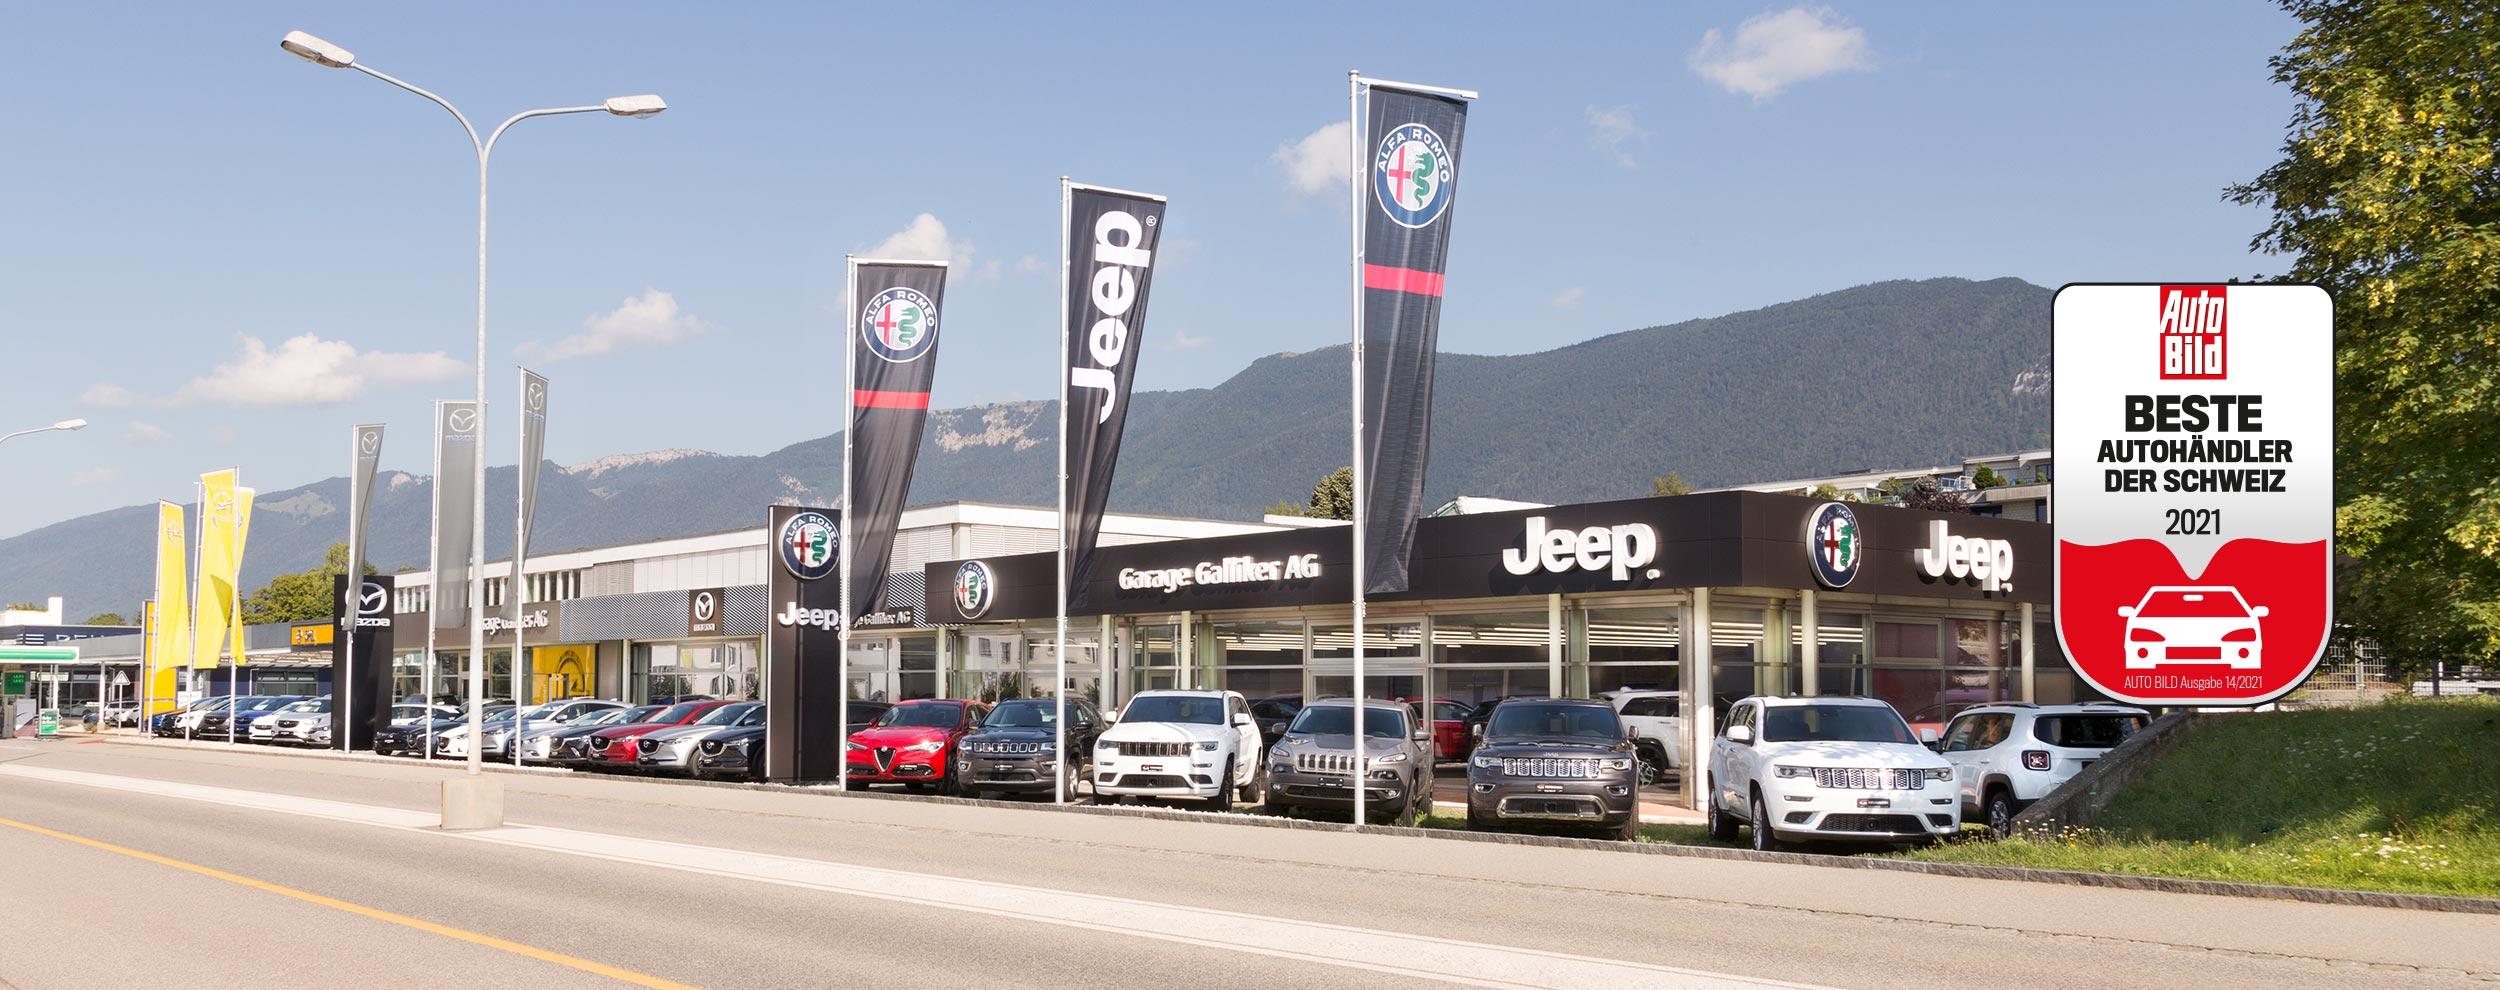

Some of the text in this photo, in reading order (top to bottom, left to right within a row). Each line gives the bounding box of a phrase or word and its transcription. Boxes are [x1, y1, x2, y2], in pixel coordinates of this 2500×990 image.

[1378, 128, 1450, 183] ALFA ROMEO
[865, 290, 935, 328] ALFA ROMEO
[1071, 210, 1151, 425] Jeep
[785, 515, 838, 548] ALFA ROMEO
[1502, 516, 1657, 581] Jeep
[1118, 553, 1322, 594] Garage Galliker AG
[1913, 519, 2014, 592] Jeep
[533, 609, 548, 627] AG
[777, 601, 839, 631] Jeep
[896, 610, 911, 624] AG
